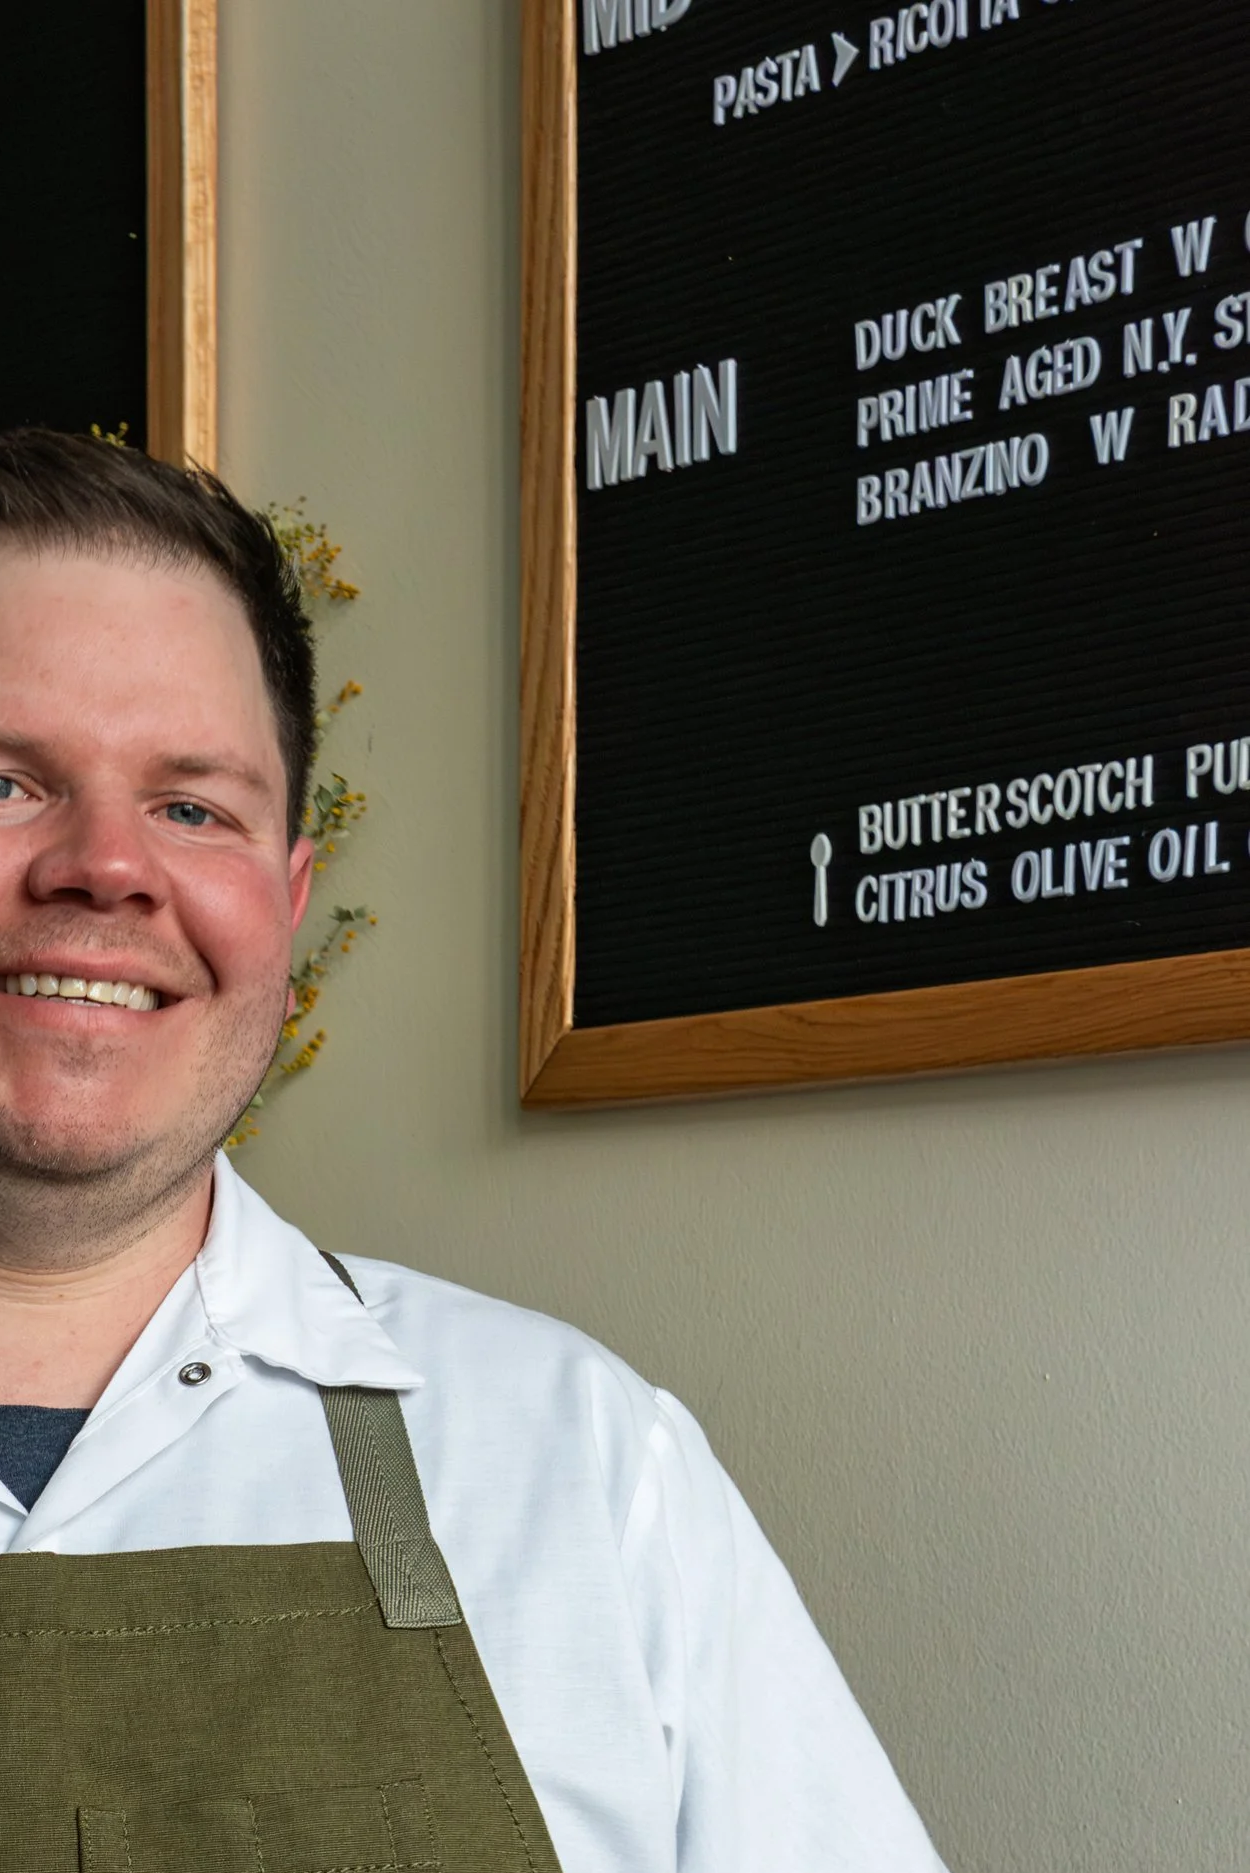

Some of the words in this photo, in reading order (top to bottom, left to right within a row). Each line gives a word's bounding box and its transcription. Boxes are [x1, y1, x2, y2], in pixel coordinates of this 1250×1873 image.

[713, 44, 821, 125] PASTA
[854, 293, 962, 371] DUCK
[984, 238, 1143, 334] BREAST
[1171, 215, 1217, 277] W
[586, 358, 737, 490] MAIN
[857, 369, 974, 448] PRIME
[998, 336, 1101, 410] AGED
[1123, 306, 1198, 378] N.Y.
[856, 432, 1049, 526] BRANZINO
[1090, 407, 1135, 465] W
[858, 754, 1154, 854] BUTTERSCOTCH
[855, 858, 988, 924] CITRUS
[1011, 835, 1131, 903] OLIVE
[1149, 821, 1231, 883] OIL
